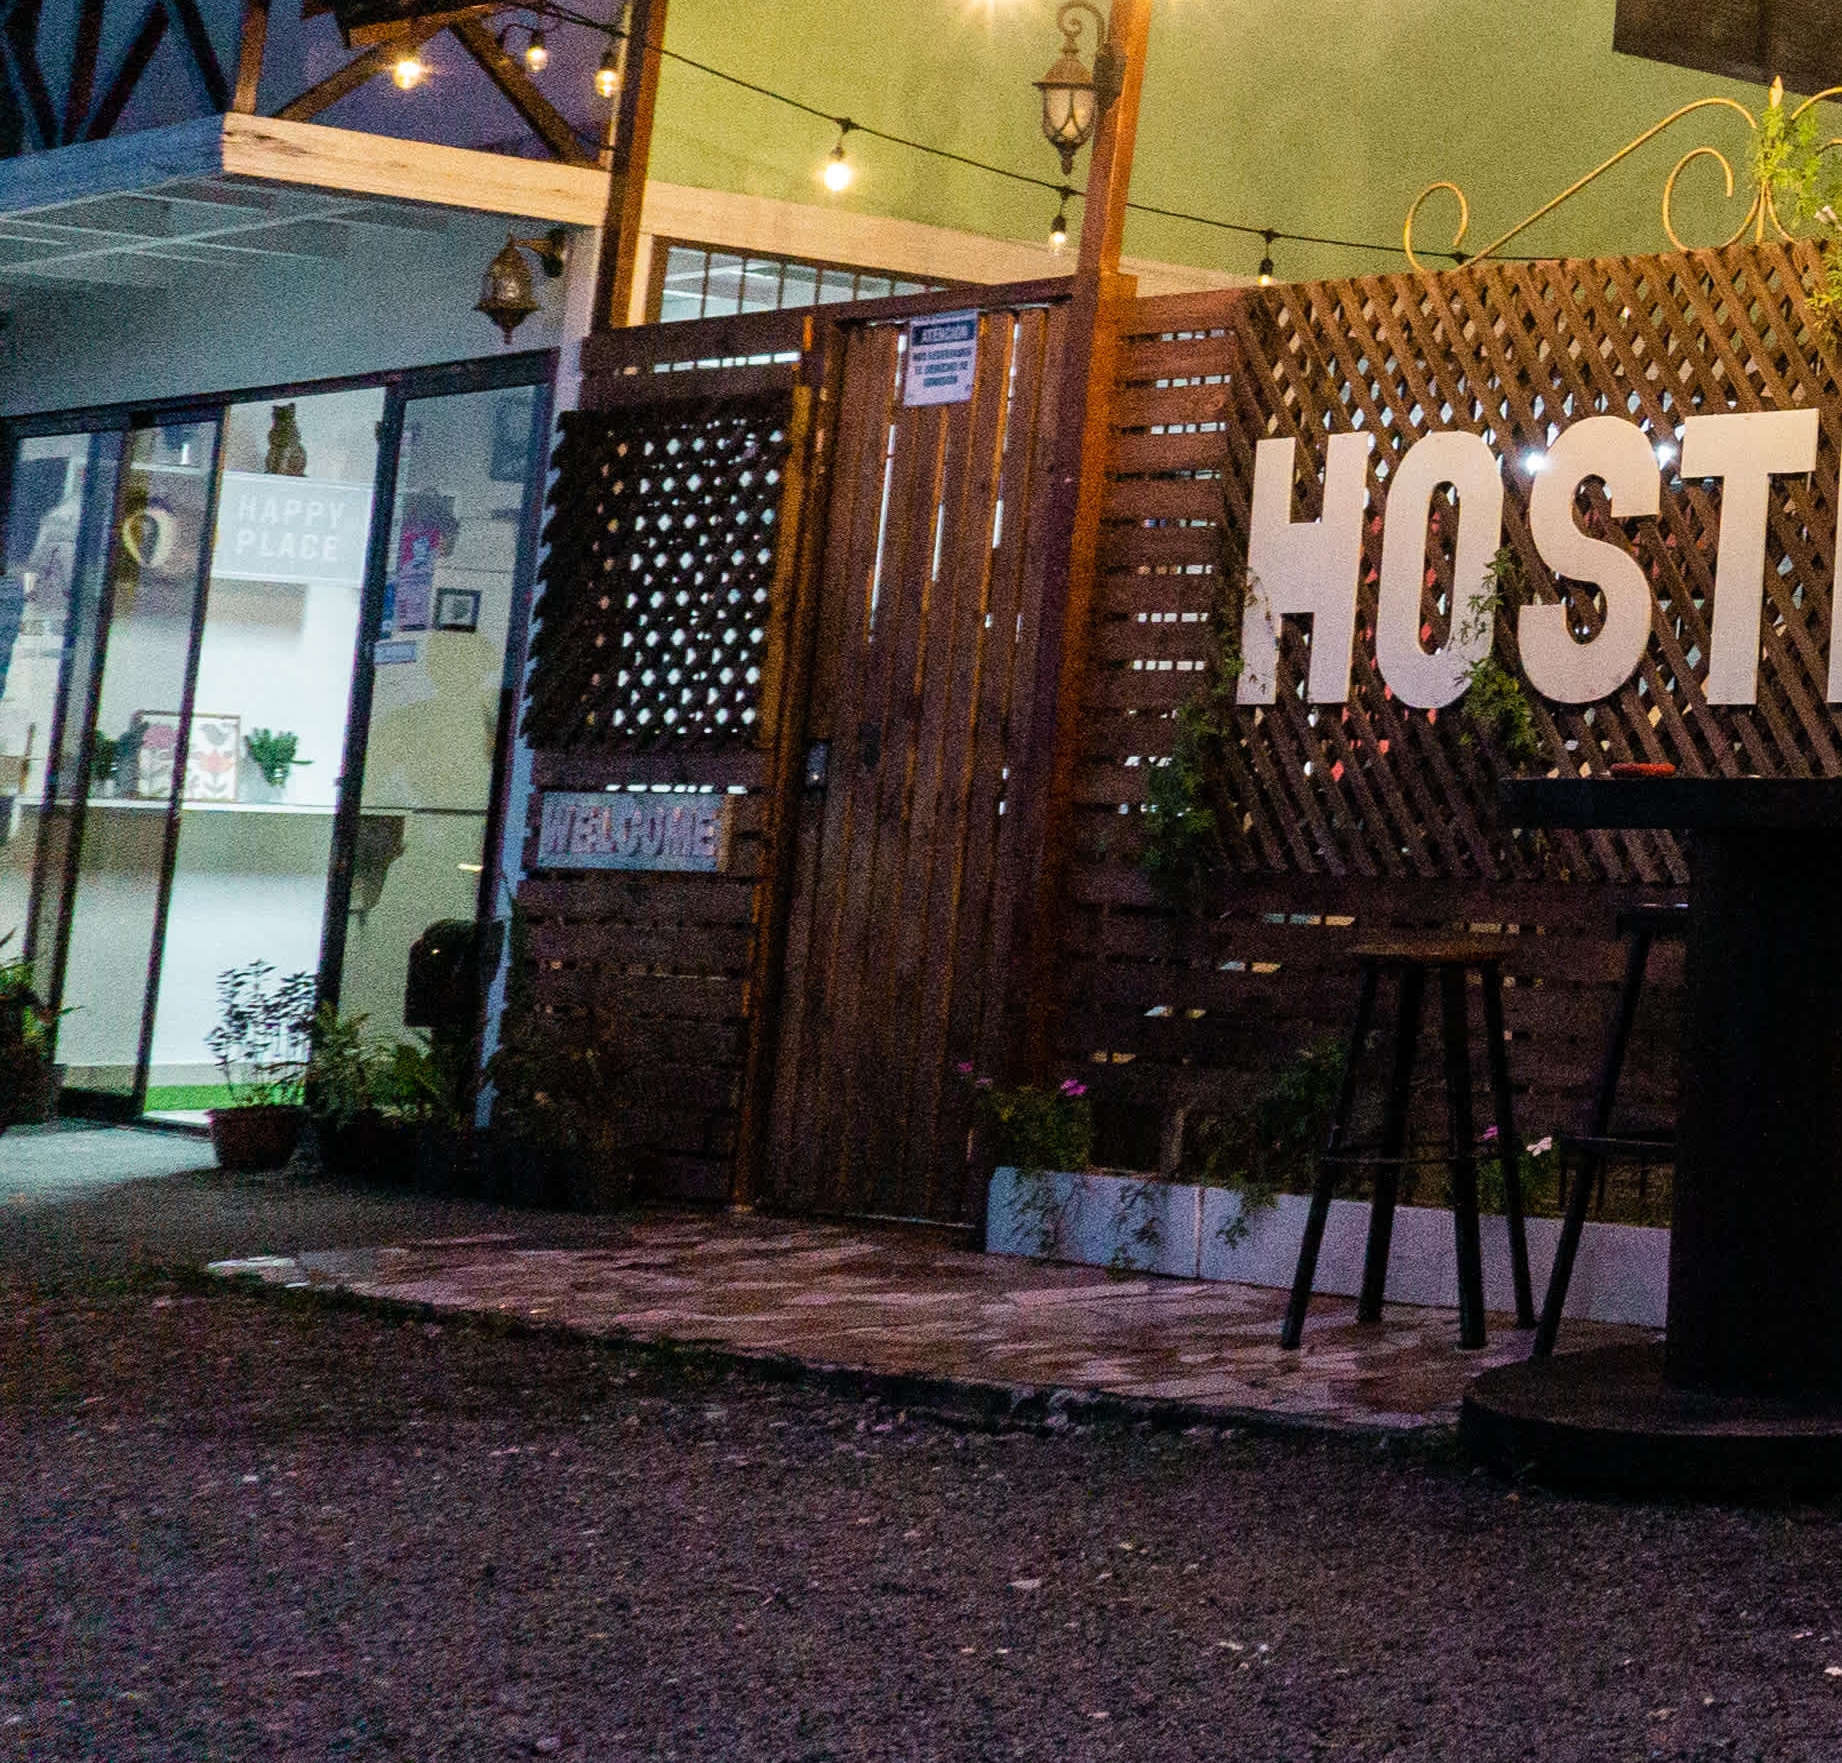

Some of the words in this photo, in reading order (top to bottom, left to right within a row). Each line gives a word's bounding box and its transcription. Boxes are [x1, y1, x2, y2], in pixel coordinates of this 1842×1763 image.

[237, 494, 345, 528] HAPPY
[234, 529, 339, 561] PLACE
[541, 805, 719, 858] WELCOME
